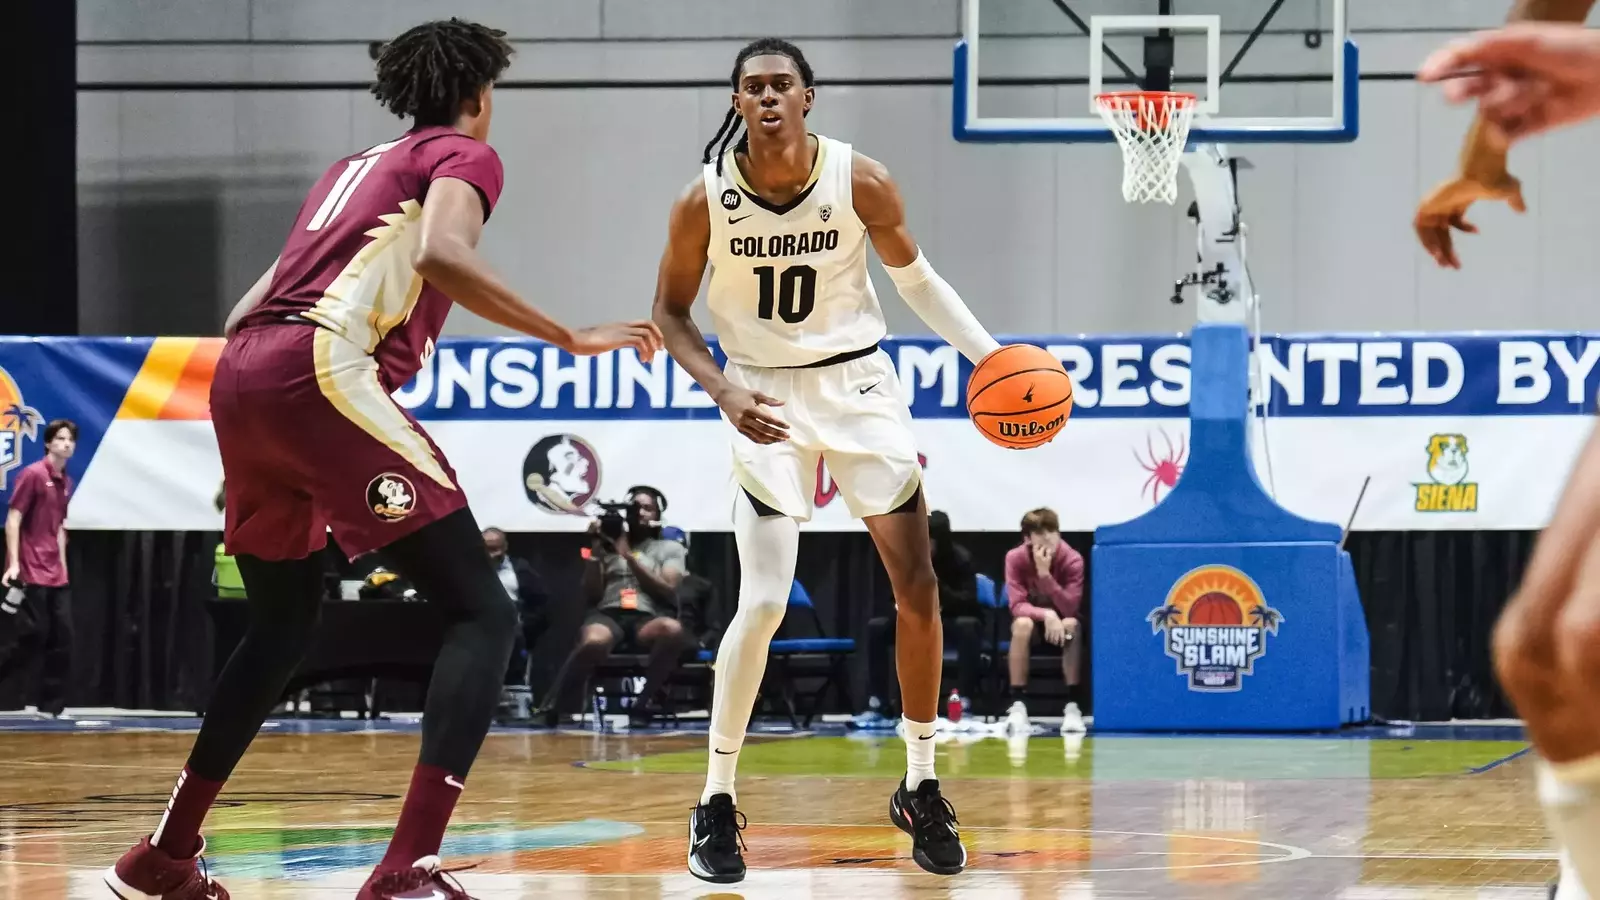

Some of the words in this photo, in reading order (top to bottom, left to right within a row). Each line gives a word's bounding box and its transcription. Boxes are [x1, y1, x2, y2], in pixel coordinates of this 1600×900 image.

[306, 154, 382, 231] 11
[723, 193, 738, 206] BH
[729, 229, 839, 257] COLORADO
[753, 264, 817, 324] 10
[390, 346, 718, 410] UNSHINE
[1046, 341, 1465, 409] RESNTED
[1496, 340, 1600, 405] BY
[998, 414, 1064, 437] Wilson
[1415, 483, 1478, 512] SIENA
[1171, 627, 1259, 655] SUNSHINE
[1184, 645, 1246, 667] SLAM
